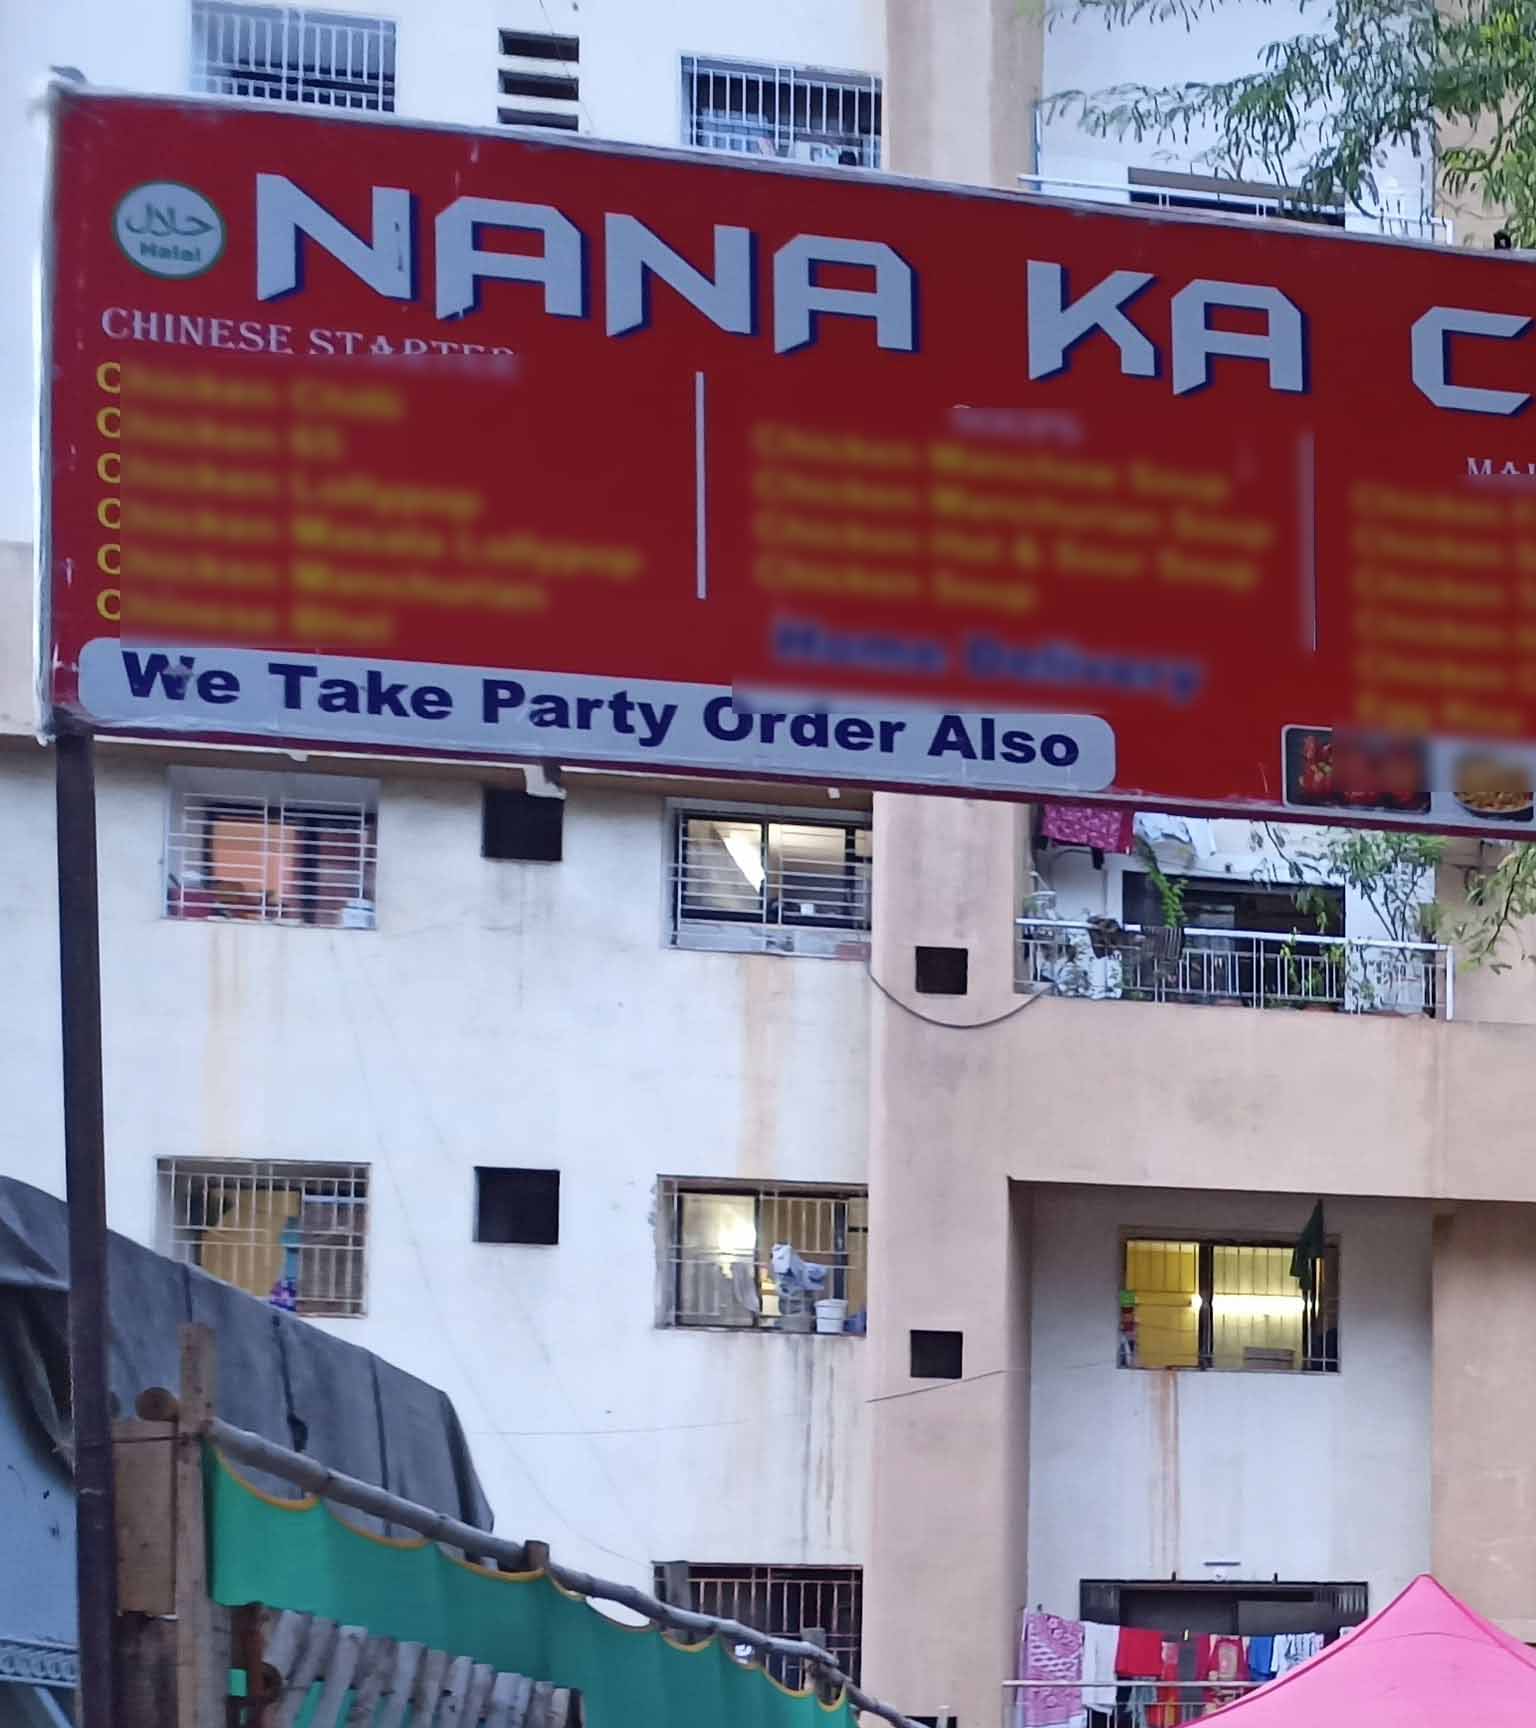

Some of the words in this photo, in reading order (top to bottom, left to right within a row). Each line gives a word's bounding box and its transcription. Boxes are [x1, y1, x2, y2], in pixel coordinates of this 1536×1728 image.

[102, 307, 295, 354] CHINESE
[256, 172, 916, 355] NANA
[1027, 260, 1308, 395] KA
[121, 650, 241, 703] We
[268, 663, 454, 719] Take
[482, 678, 679, 748] Party
[702, 696, 906, 754] Order
[927, 714, 1080, 767] Also
